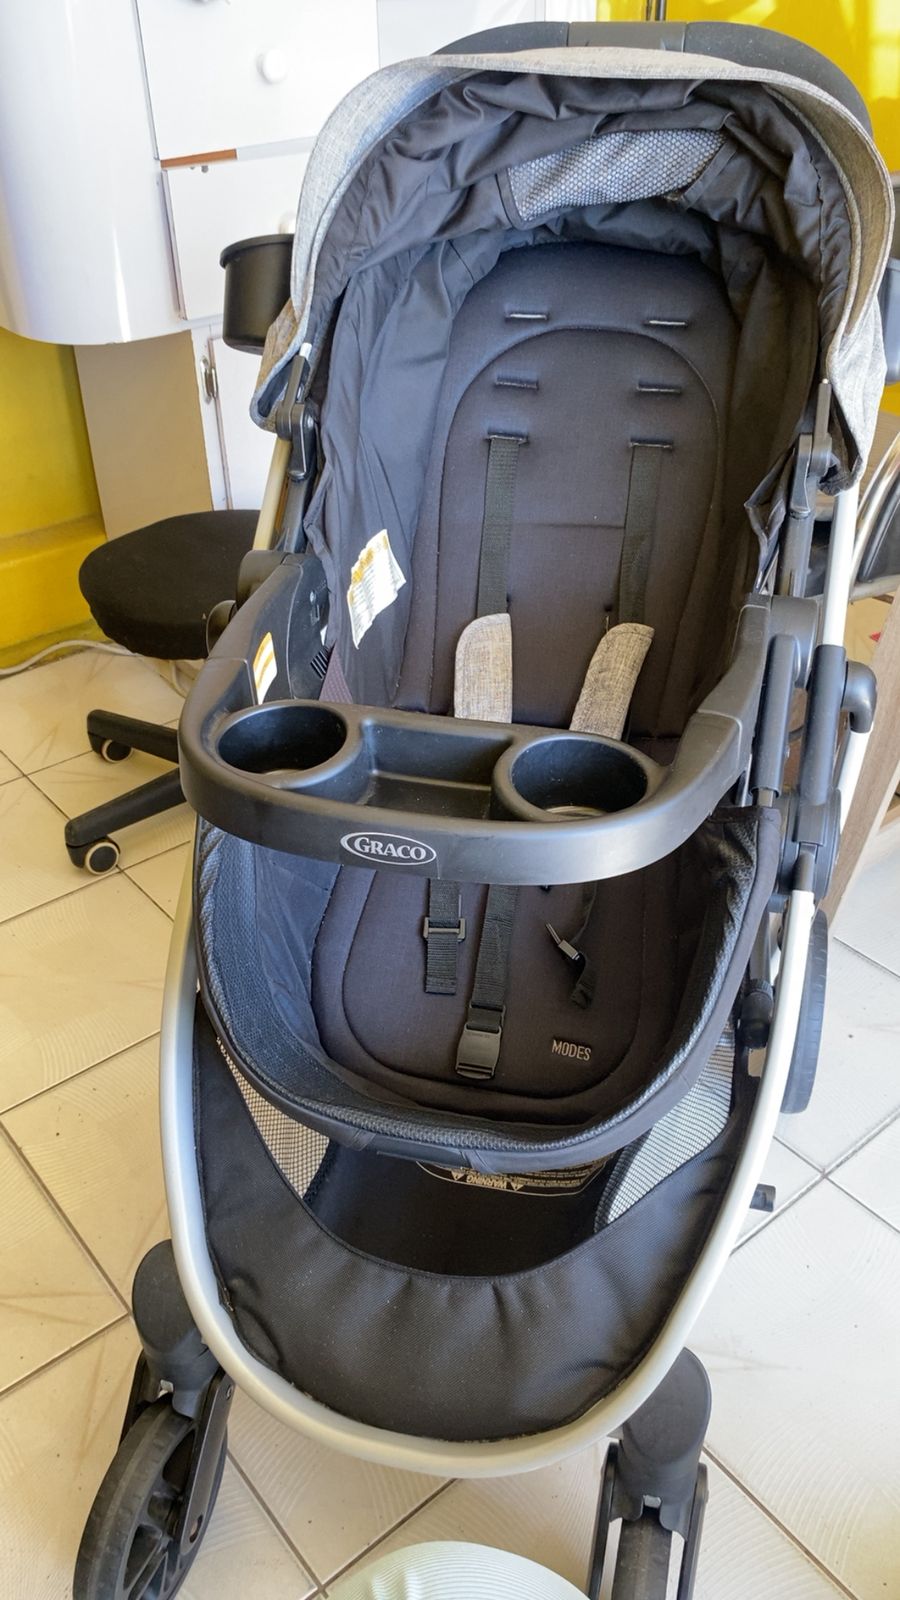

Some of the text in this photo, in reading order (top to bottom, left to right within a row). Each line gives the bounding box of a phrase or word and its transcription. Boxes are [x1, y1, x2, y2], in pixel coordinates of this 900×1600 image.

[354, 836, 427, 861] GRACO
[551, 1039, 592, 1061] MODES
[466, 1174, 507, 1189] WARNING
